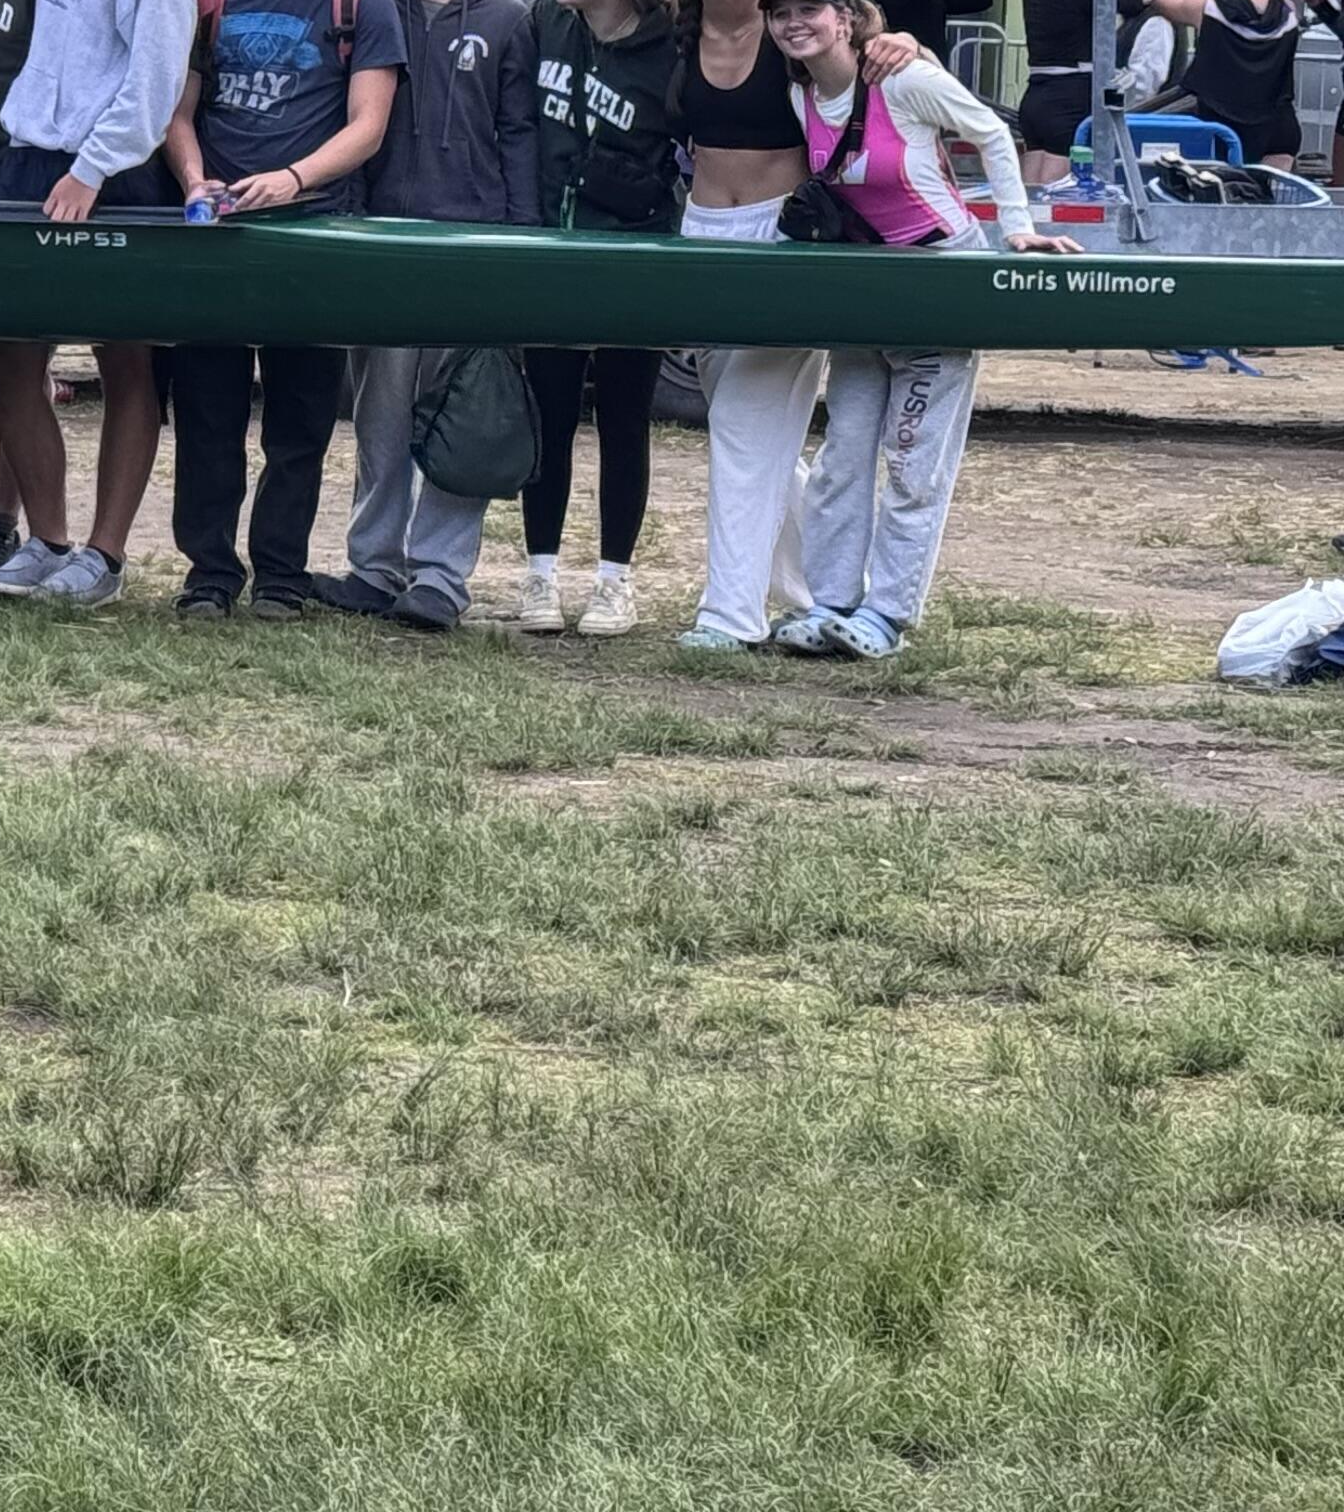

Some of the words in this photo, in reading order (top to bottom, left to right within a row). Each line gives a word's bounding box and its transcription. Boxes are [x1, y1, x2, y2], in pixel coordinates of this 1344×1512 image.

[35, 230, 128, 247] VHP53
[993, 269, 1058, 291] Chris
[1066, 270, 1177, 294] Willmore
